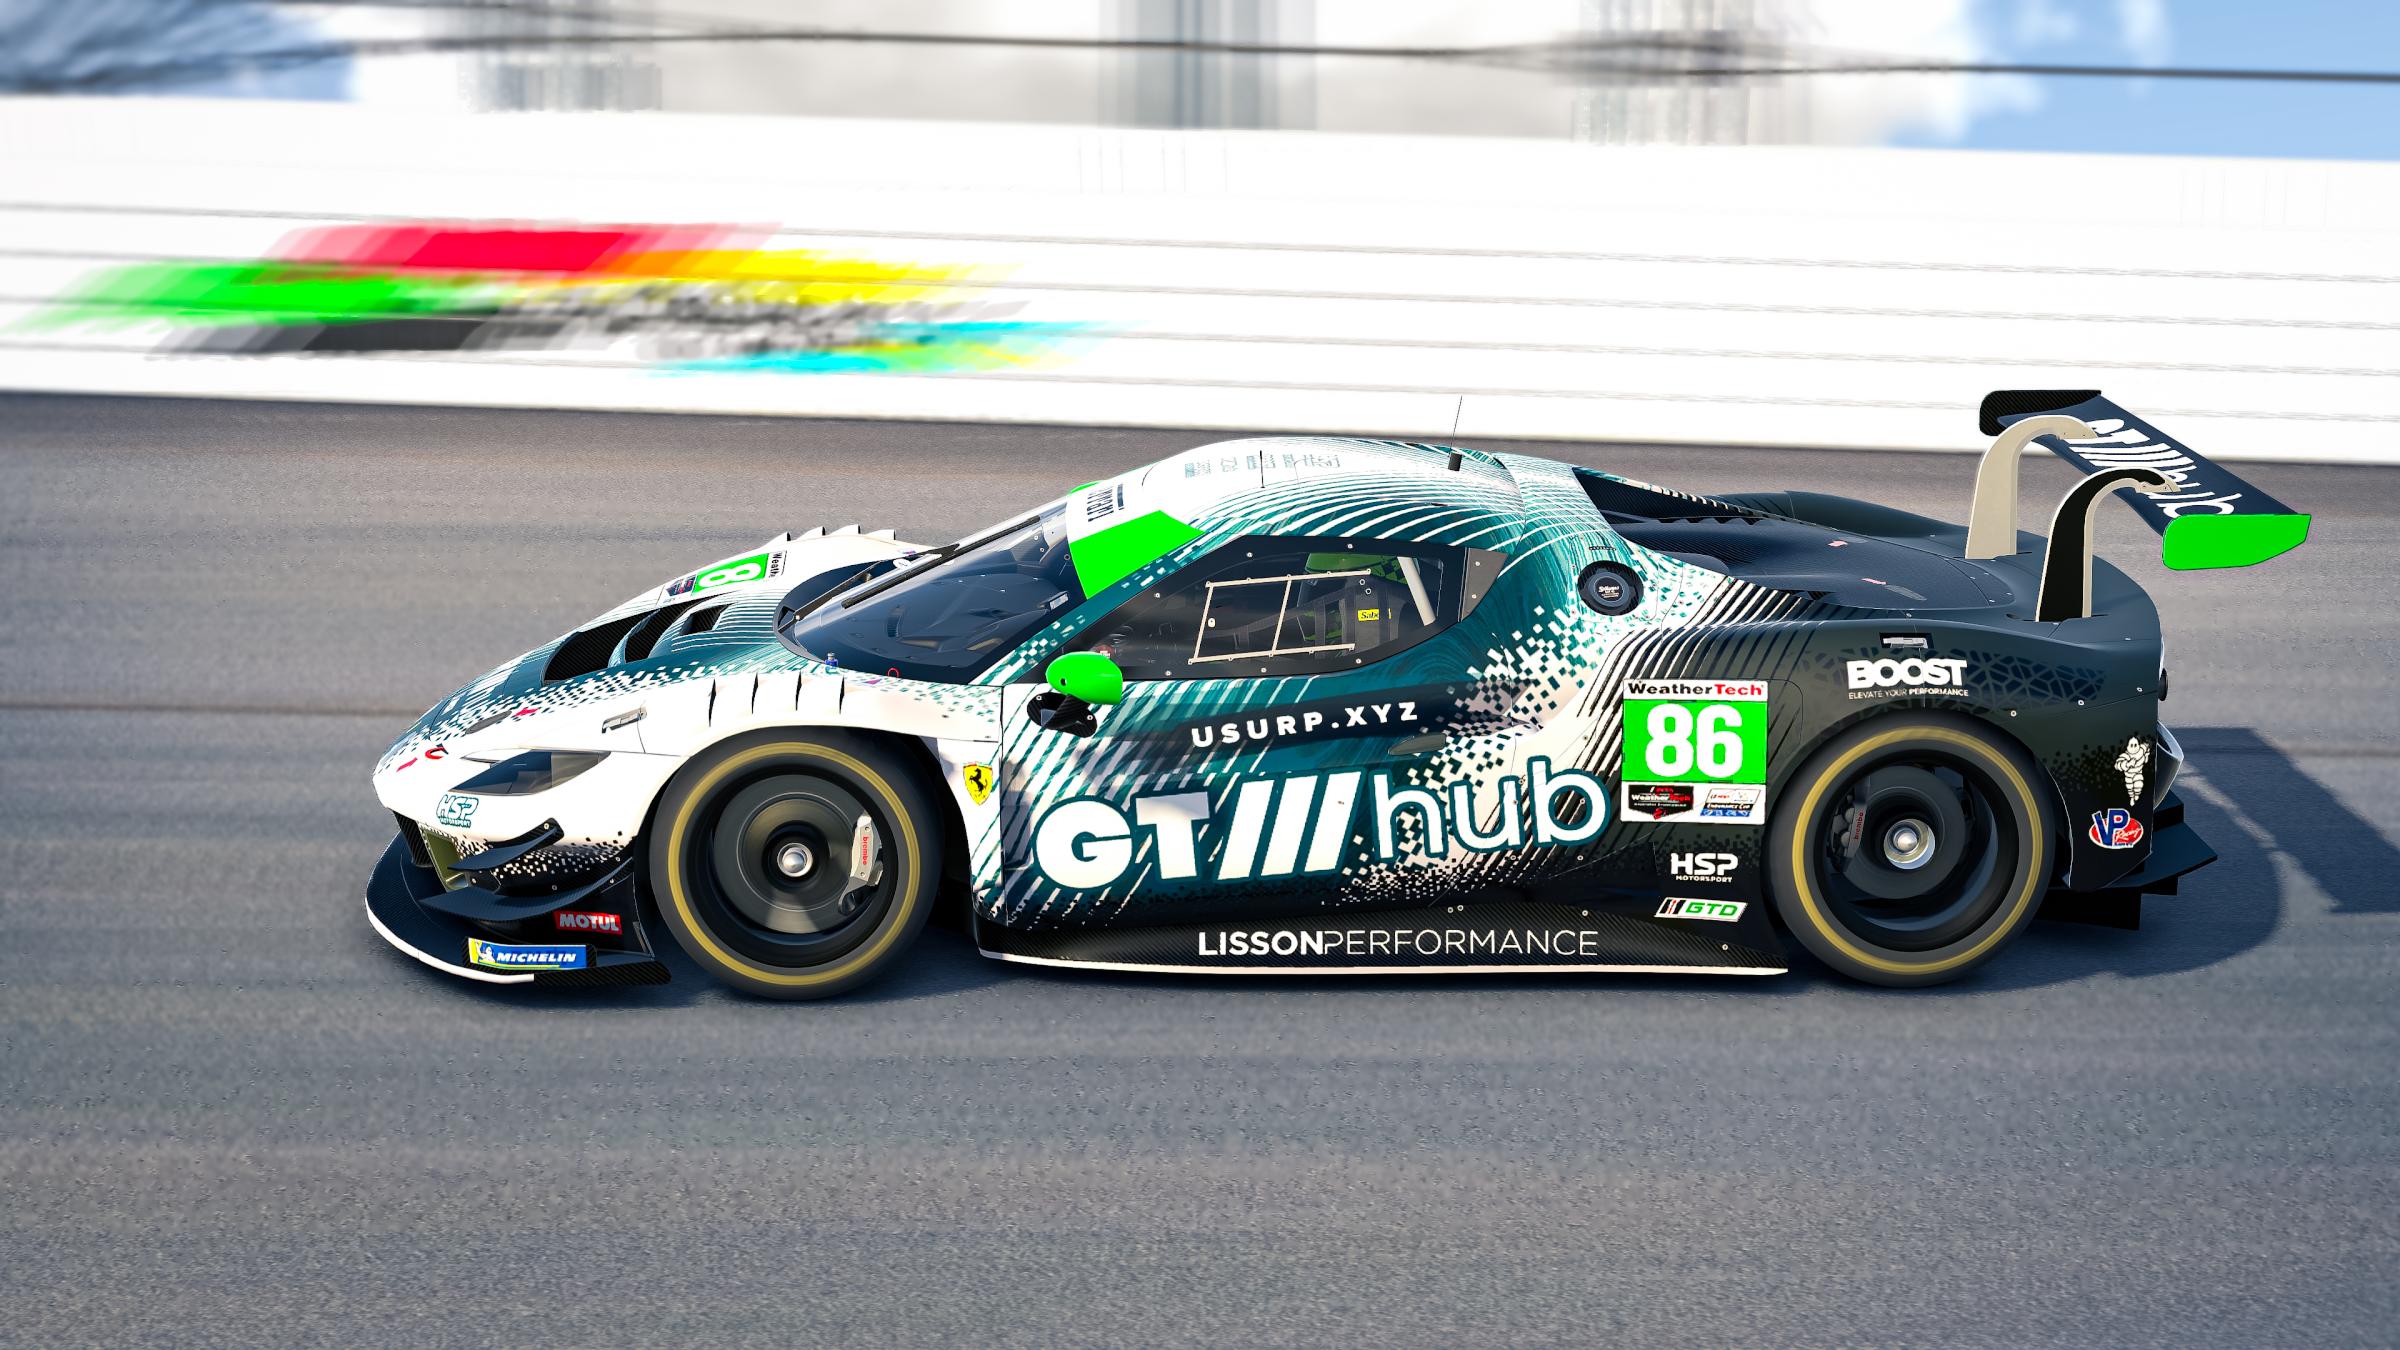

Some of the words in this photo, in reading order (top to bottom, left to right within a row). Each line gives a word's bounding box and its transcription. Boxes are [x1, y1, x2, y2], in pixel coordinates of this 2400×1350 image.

[1846, 657, 1968, 690] BOOST
[1628, 682, 1762, 696] WeatherTech
[1848, 690, 1883, 700] ELEVATE
[1885, 689, 1907, 697] YOUR
[1908, 687, 1969, 697] PERFORMANCE
[1192, 701, 1418, 748] USURP.XYZ
[1645, 703, 1744, 778] 86
[436, 794, 479, 820] HSP
[2091, 808, 2130, 847] VP
[1670, 853, 1738, 875] HSP
[1675, 875, 1733, 883] MOTORSPORT
[1685, 902, 1738, 916] GTD
[559, 913, 620, 931] MOTUL
[497, 952, 576, 963] MICHELIN
